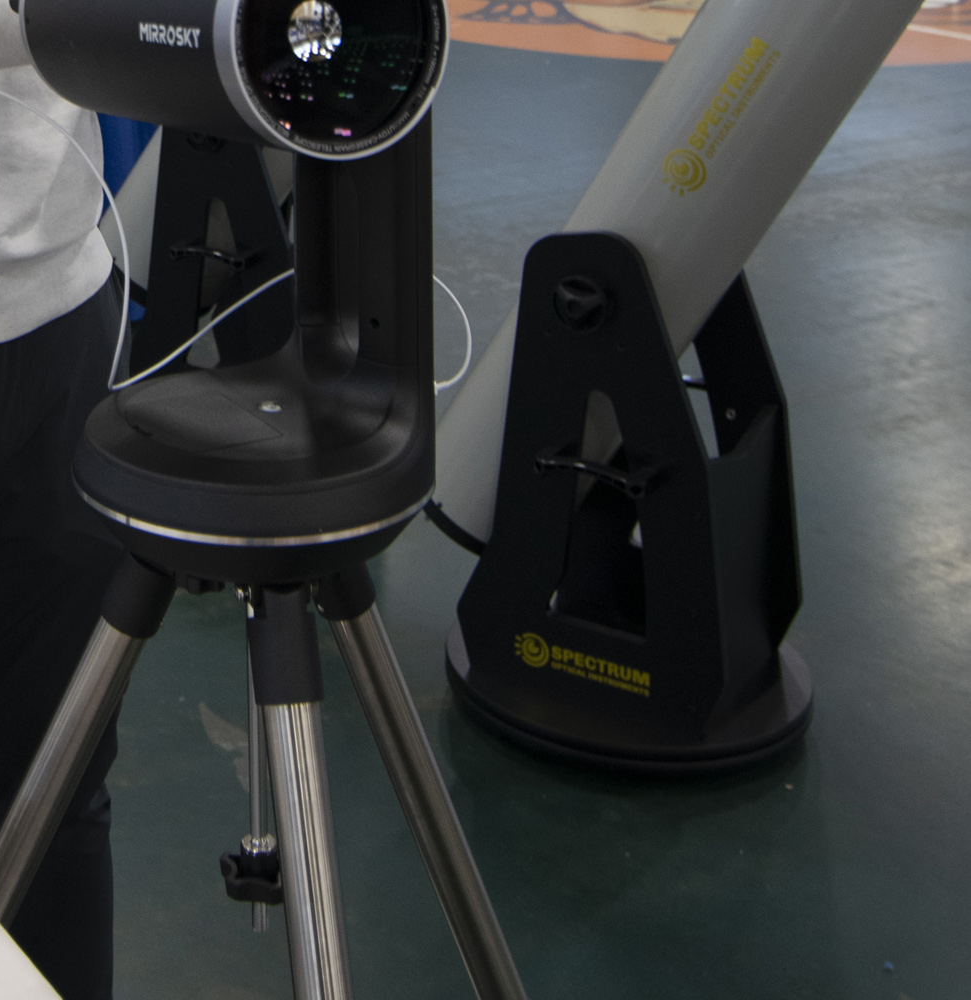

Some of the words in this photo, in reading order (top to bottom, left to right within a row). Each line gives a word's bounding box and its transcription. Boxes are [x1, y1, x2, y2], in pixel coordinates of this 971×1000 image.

[138, 22, 202, 49] MIRROSKY
[688, 36, 769, 150] SPECTRUM
[705, 119, 736, 159] OPTICAL
[551, 645, 651, 687] SPECTRUM
[551, 661, 587, 678] OPTICAL
